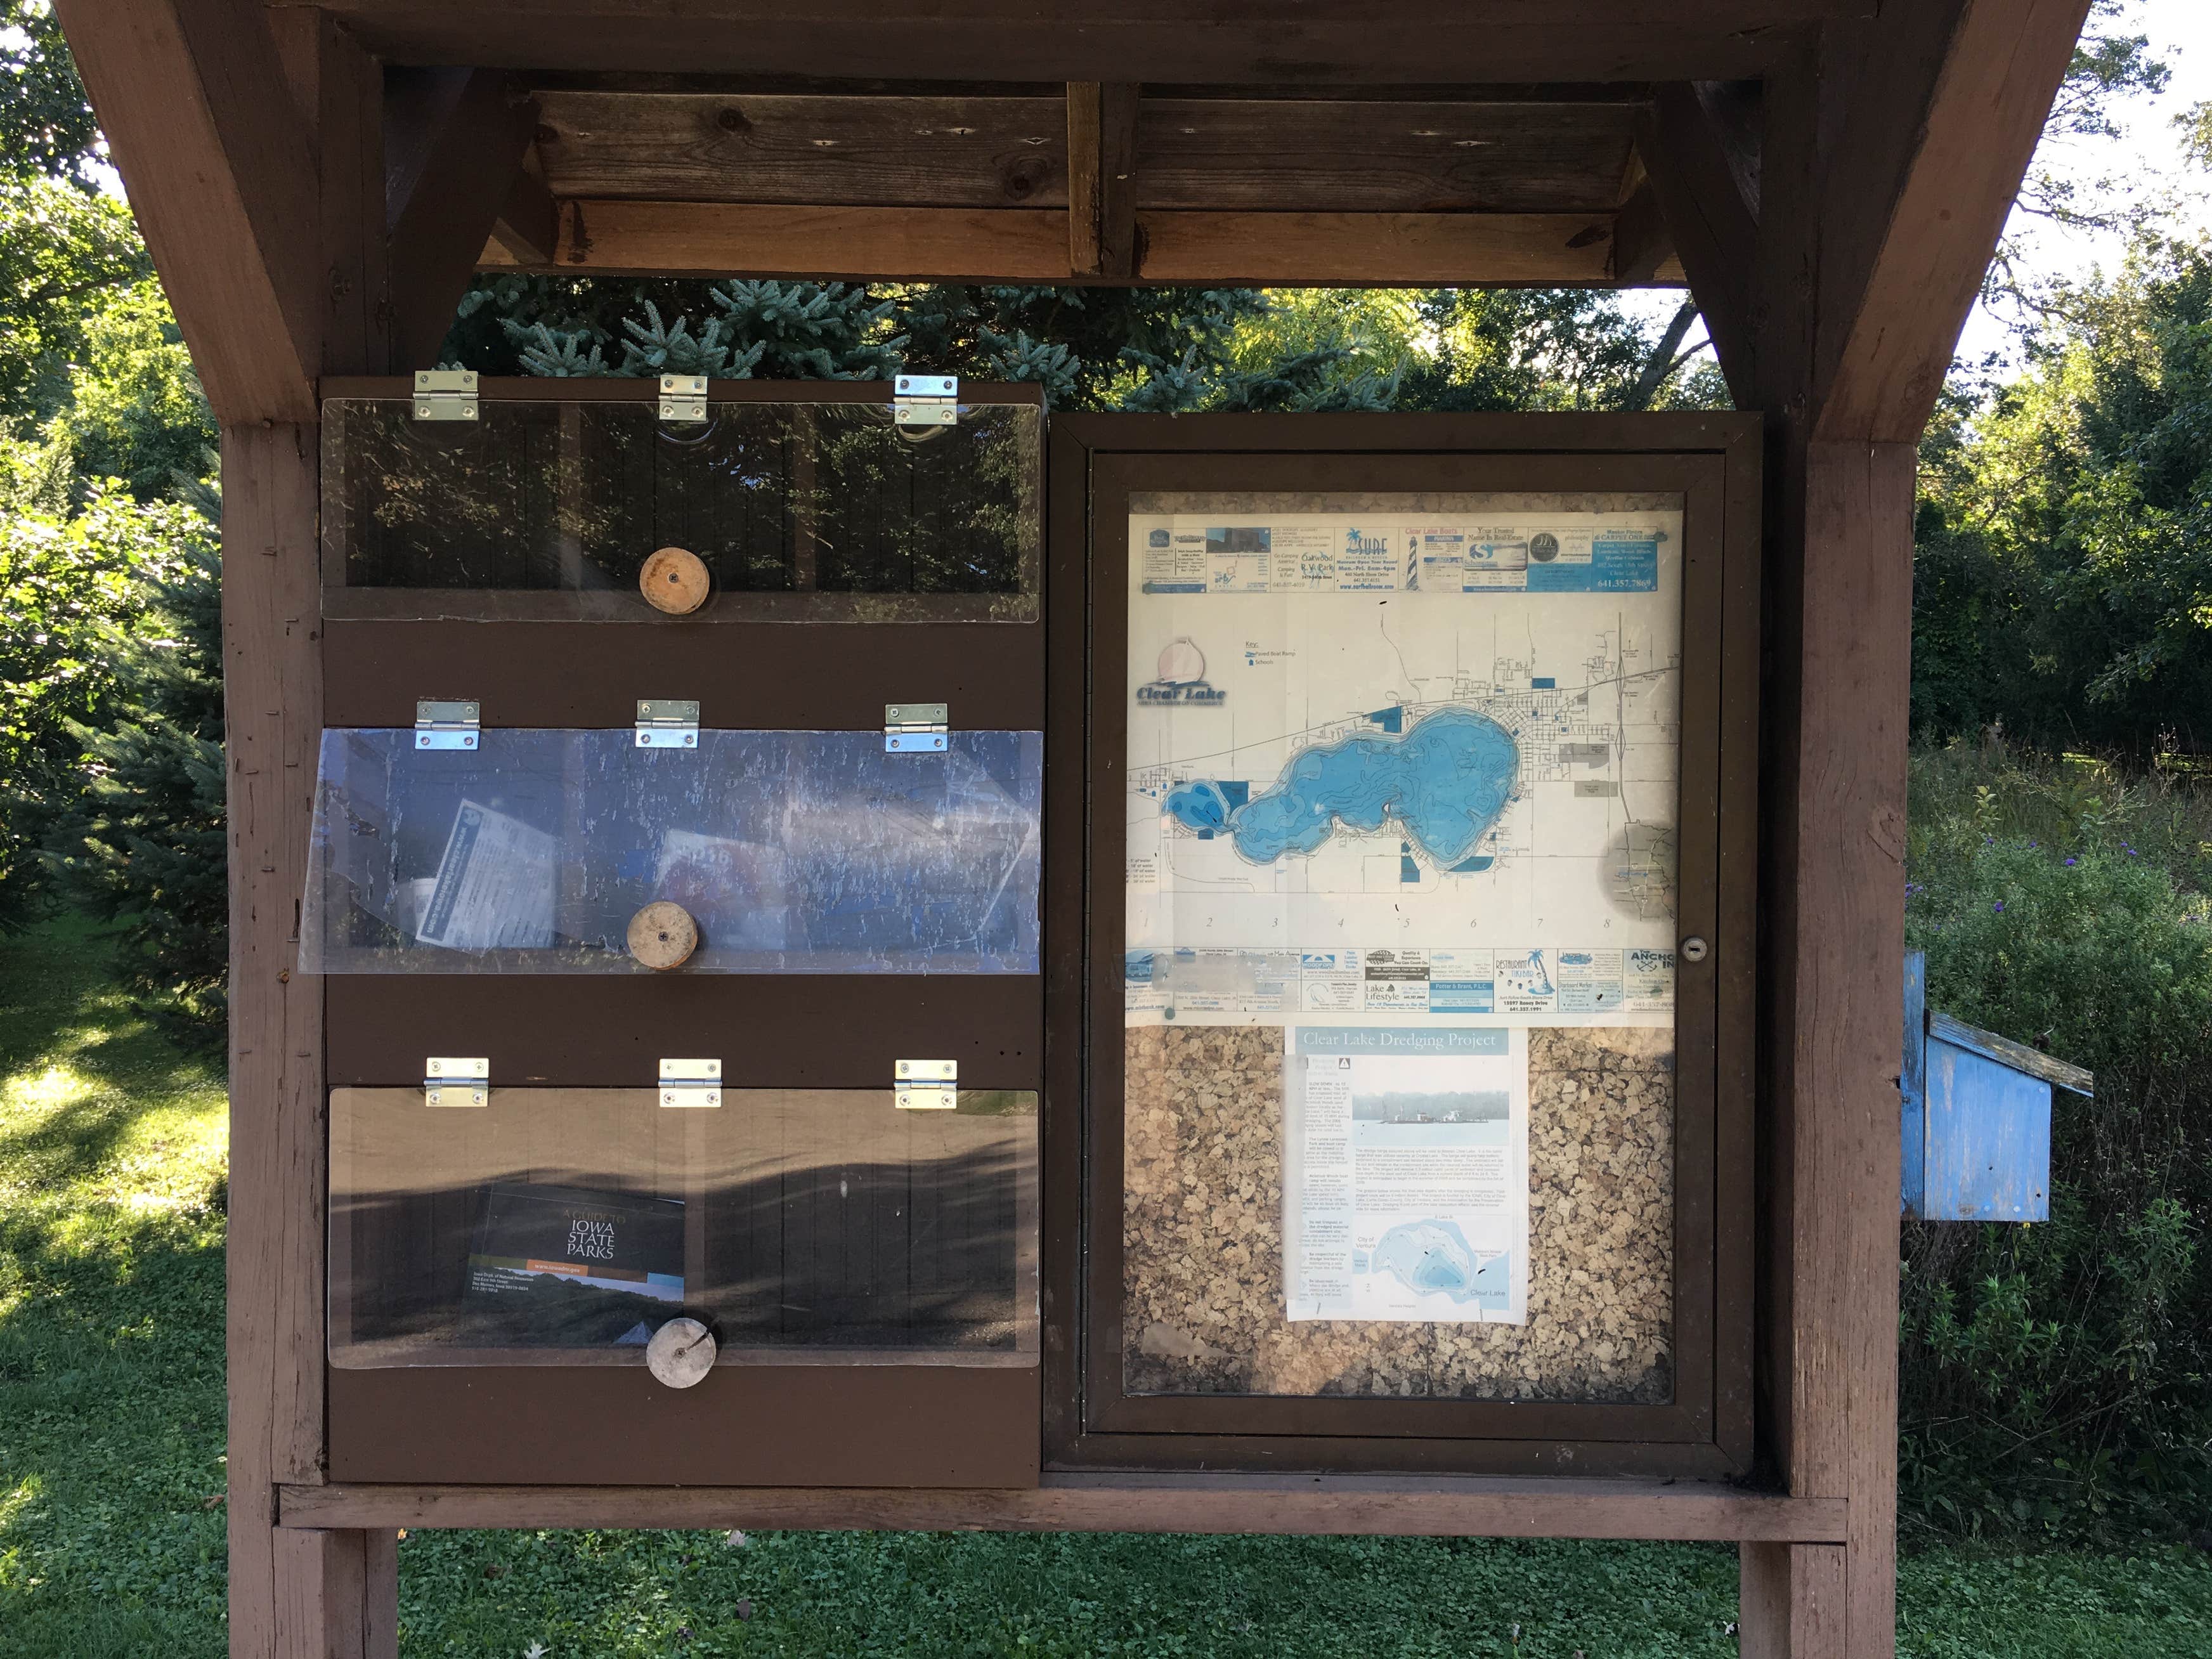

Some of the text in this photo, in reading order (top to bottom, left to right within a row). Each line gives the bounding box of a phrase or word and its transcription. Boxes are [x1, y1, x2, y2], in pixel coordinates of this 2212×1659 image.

[1358, 538, 1388, 555] SURF
[1301, 552, 1333, 562] Oakwood
[1136, 687, 1226, 699] Clear Lake
[1143, 918, 1611, 928] 1 2 3 4 5 6 7 8
[1495, 960, 1528, 970] RESTAURANT
[1366, 984, 1384, 992] Lake
[1366, 992, 1400, 1002] Lifestyle
[1303, 1032, 1496, 1050] Clear Lake Dredging Project
[563, 1209, 625, 1223] A GUIDE TO
[571, 1220, 615, 1235] IOWA
[568, 1232, 615, 1247] STATE
[566, 1244, 615, 1259] PARKS
